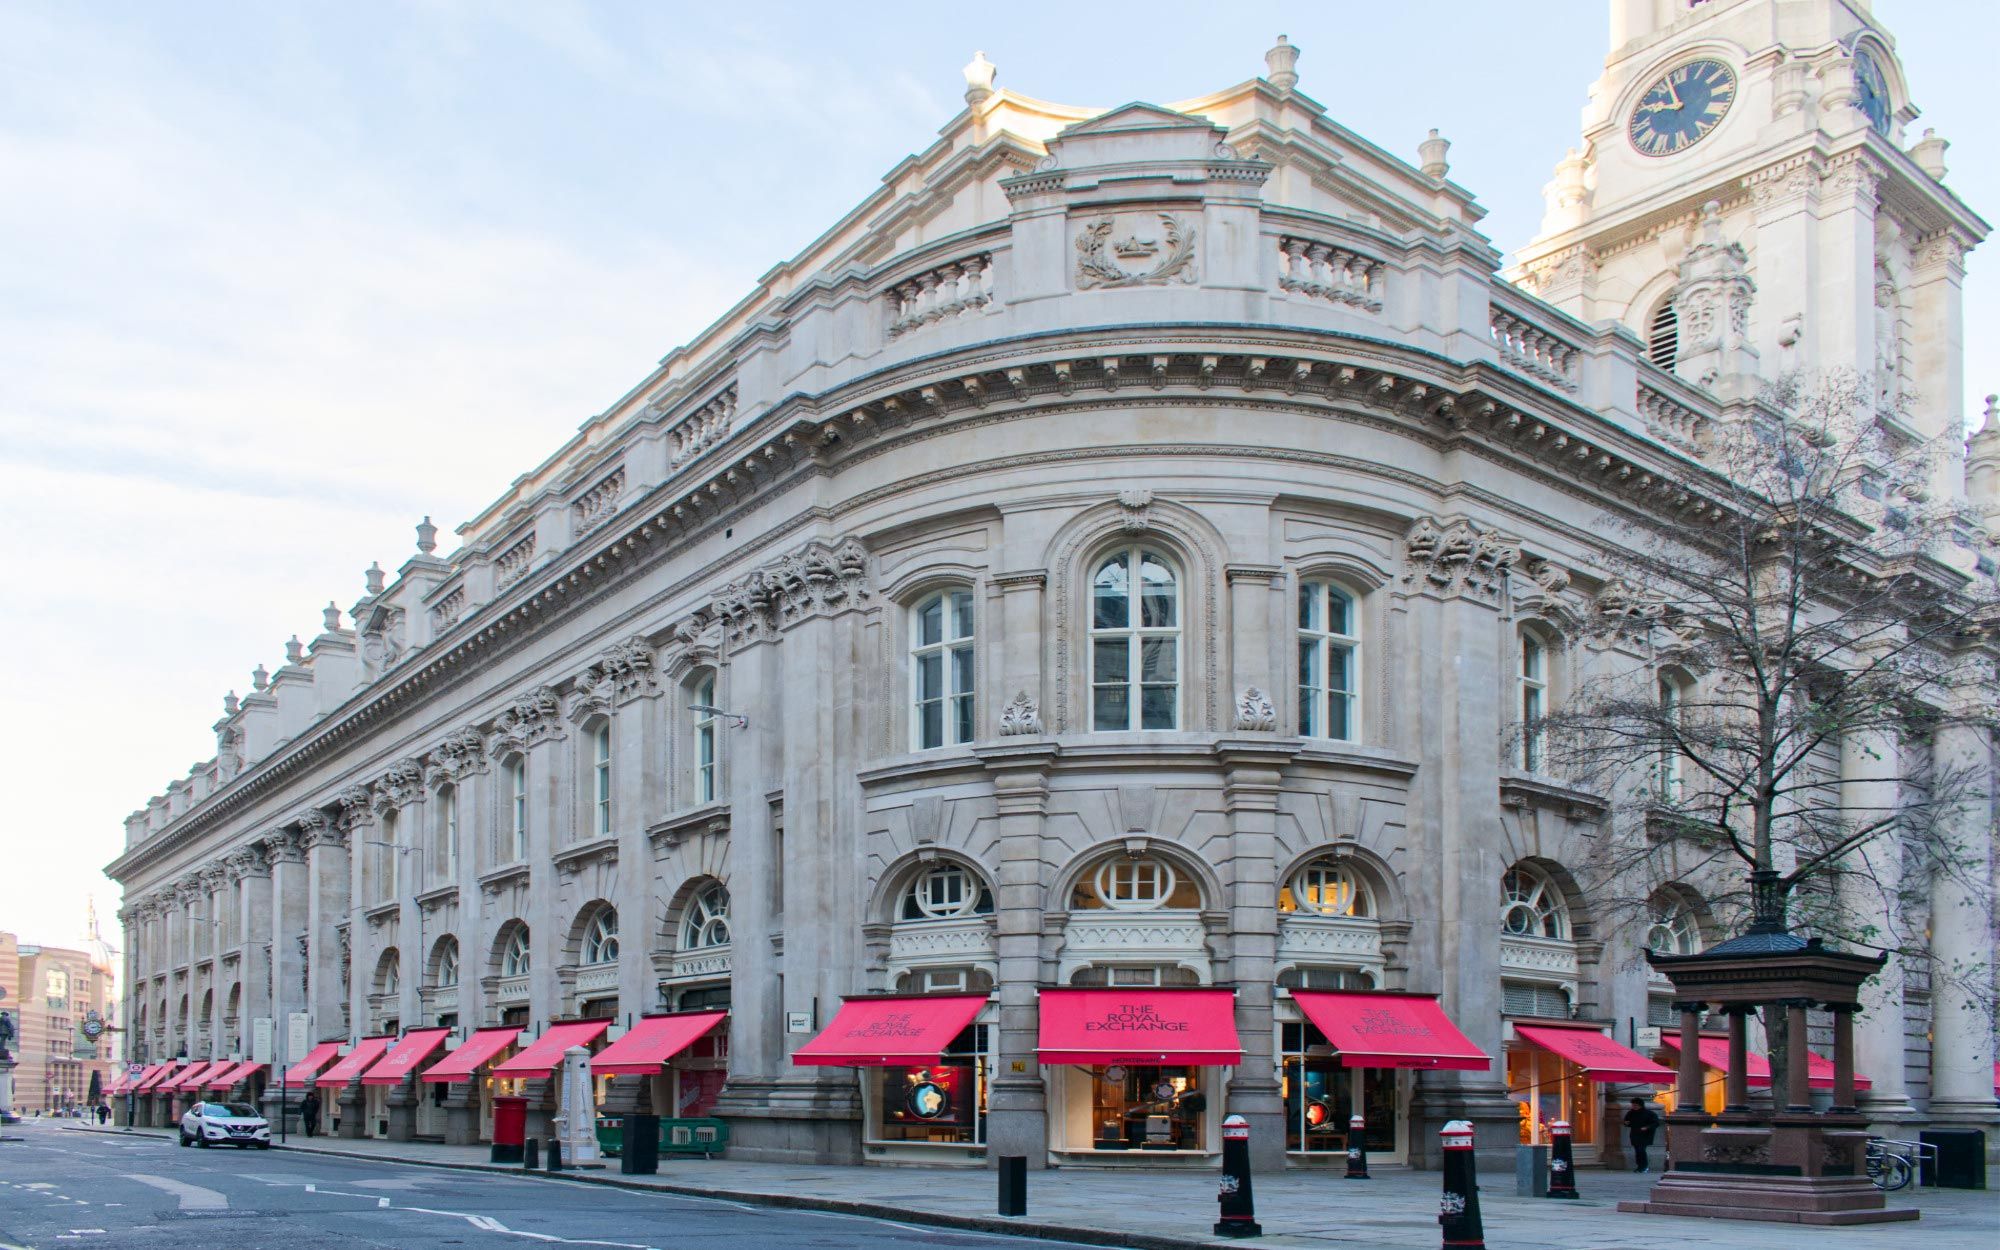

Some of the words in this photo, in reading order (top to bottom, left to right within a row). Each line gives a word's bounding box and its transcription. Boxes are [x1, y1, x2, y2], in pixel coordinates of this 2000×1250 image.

[1120, 1004, 1153, 1013] THE
[1107, 1013, 1166, 1022] ROYAL
[1085, 1022, 1189, 1032] EXCHANGE
